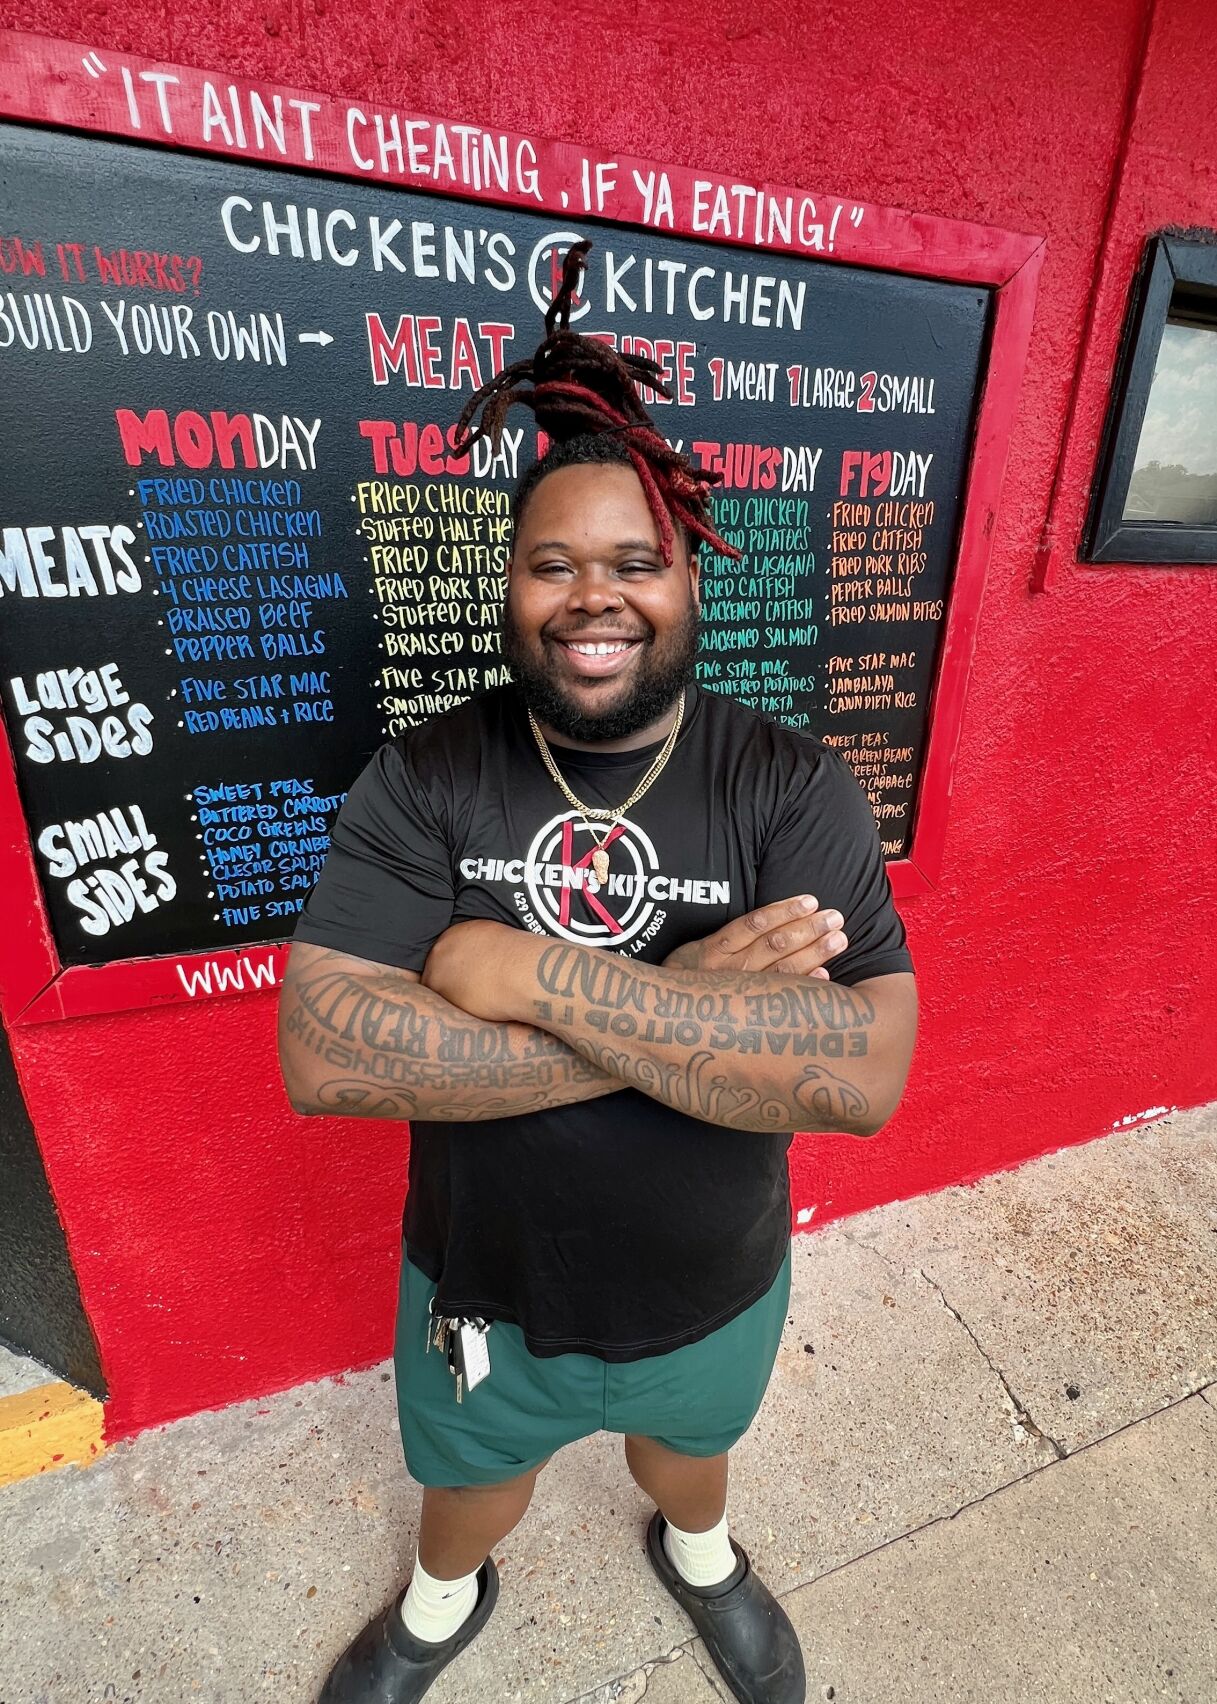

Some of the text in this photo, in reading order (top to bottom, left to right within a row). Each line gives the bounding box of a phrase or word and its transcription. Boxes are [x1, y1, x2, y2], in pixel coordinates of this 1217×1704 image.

[203, 81, 321, 161] AINT
[633, 170, 675, 229] YA
[0, 236, 46, 277] OW
[56, 242, 86, 284] IT
[221, 197, 517, 292] CHICKEN'S
[605, 250, 807, 331] KITCHEN
[100, 299, 201, 359] YOUR
[208, 310, 287, 366] OWN
[366, 312, 516, 391] MEAT
[440, 515, 483, 542] HALF
[872, 529, 922, 551] CATFISH
[0, 525, 142, 597] MEATS
[223, 541, 309, 571] CATFISH
[753, 551, 815, 577] LASAGNA
[865, 555, 893, 576] PORK
[897, 552, 928, 575] RIBS
[161, 579, 180, 605] 4
[256, 572, 349, 600] LASAGNA
[429, 575, 473, 601] PORK
[738, 576, 795, 599] CATFISH
[876, 575, 914, 598] BALLS
[765, 598, 813, 622] CATFISH
[868, 601, 910, 623] SALMON
[260, 629, 326, 661] BALLS
[726, 659, 757, 678] STAR
[858, 653, 886, 671] STAR
[889, 652, 916, 669] MAC
[233, 672, 284, 700] STAR
[289, 671, 331, 696] MAC
[431, 667, 480, 692] STAR
[829, 674, 894, 695] JAMBALAYA
[761, 694, 793, 712] PASTA
[861, 732, 890, 747] PEAS
[884, 747, 914, 764] BEANS
[193, 778, 314, 806] SWEET PEAS
[203, 816, 327, 846] COCO GREENS
[206, 842, 261, 867] HONEY
[216, 879, 275, 902] POTATO
[608, 872, 731, 905] KITCHEN
[513, 891, 528, 912] 629
[222, 906, 261, 927] FIVE
[630, 909, 667, 954] LA 70053
